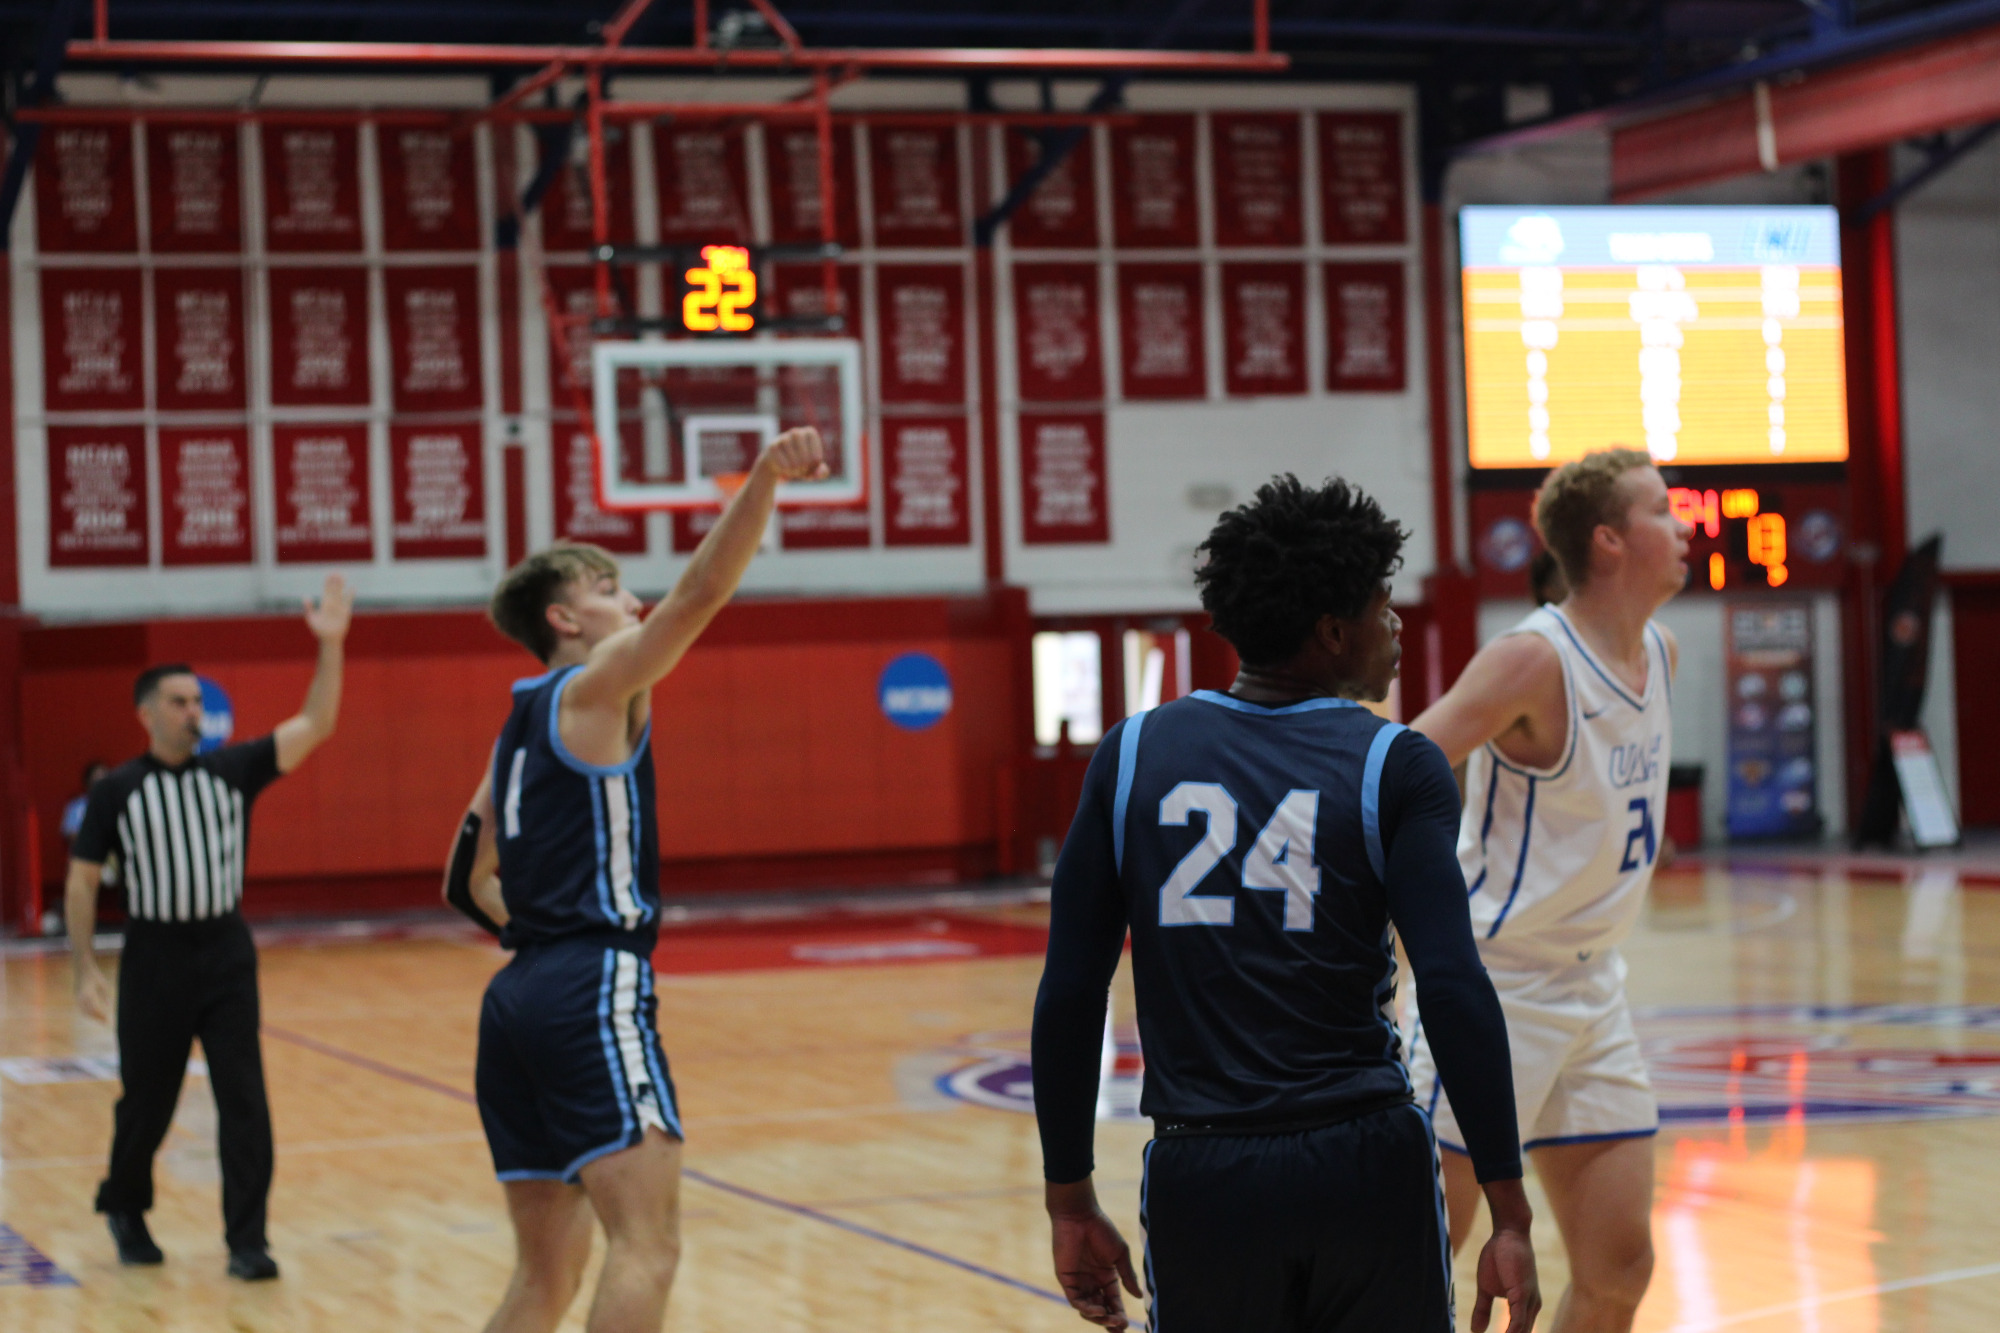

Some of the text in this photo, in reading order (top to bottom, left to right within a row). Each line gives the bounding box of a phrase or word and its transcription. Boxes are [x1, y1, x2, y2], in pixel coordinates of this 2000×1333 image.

[683, 267, 756, 331] 22
[504, 747, 527, 839] 1
[1158, 780, 1321, 932] 24
